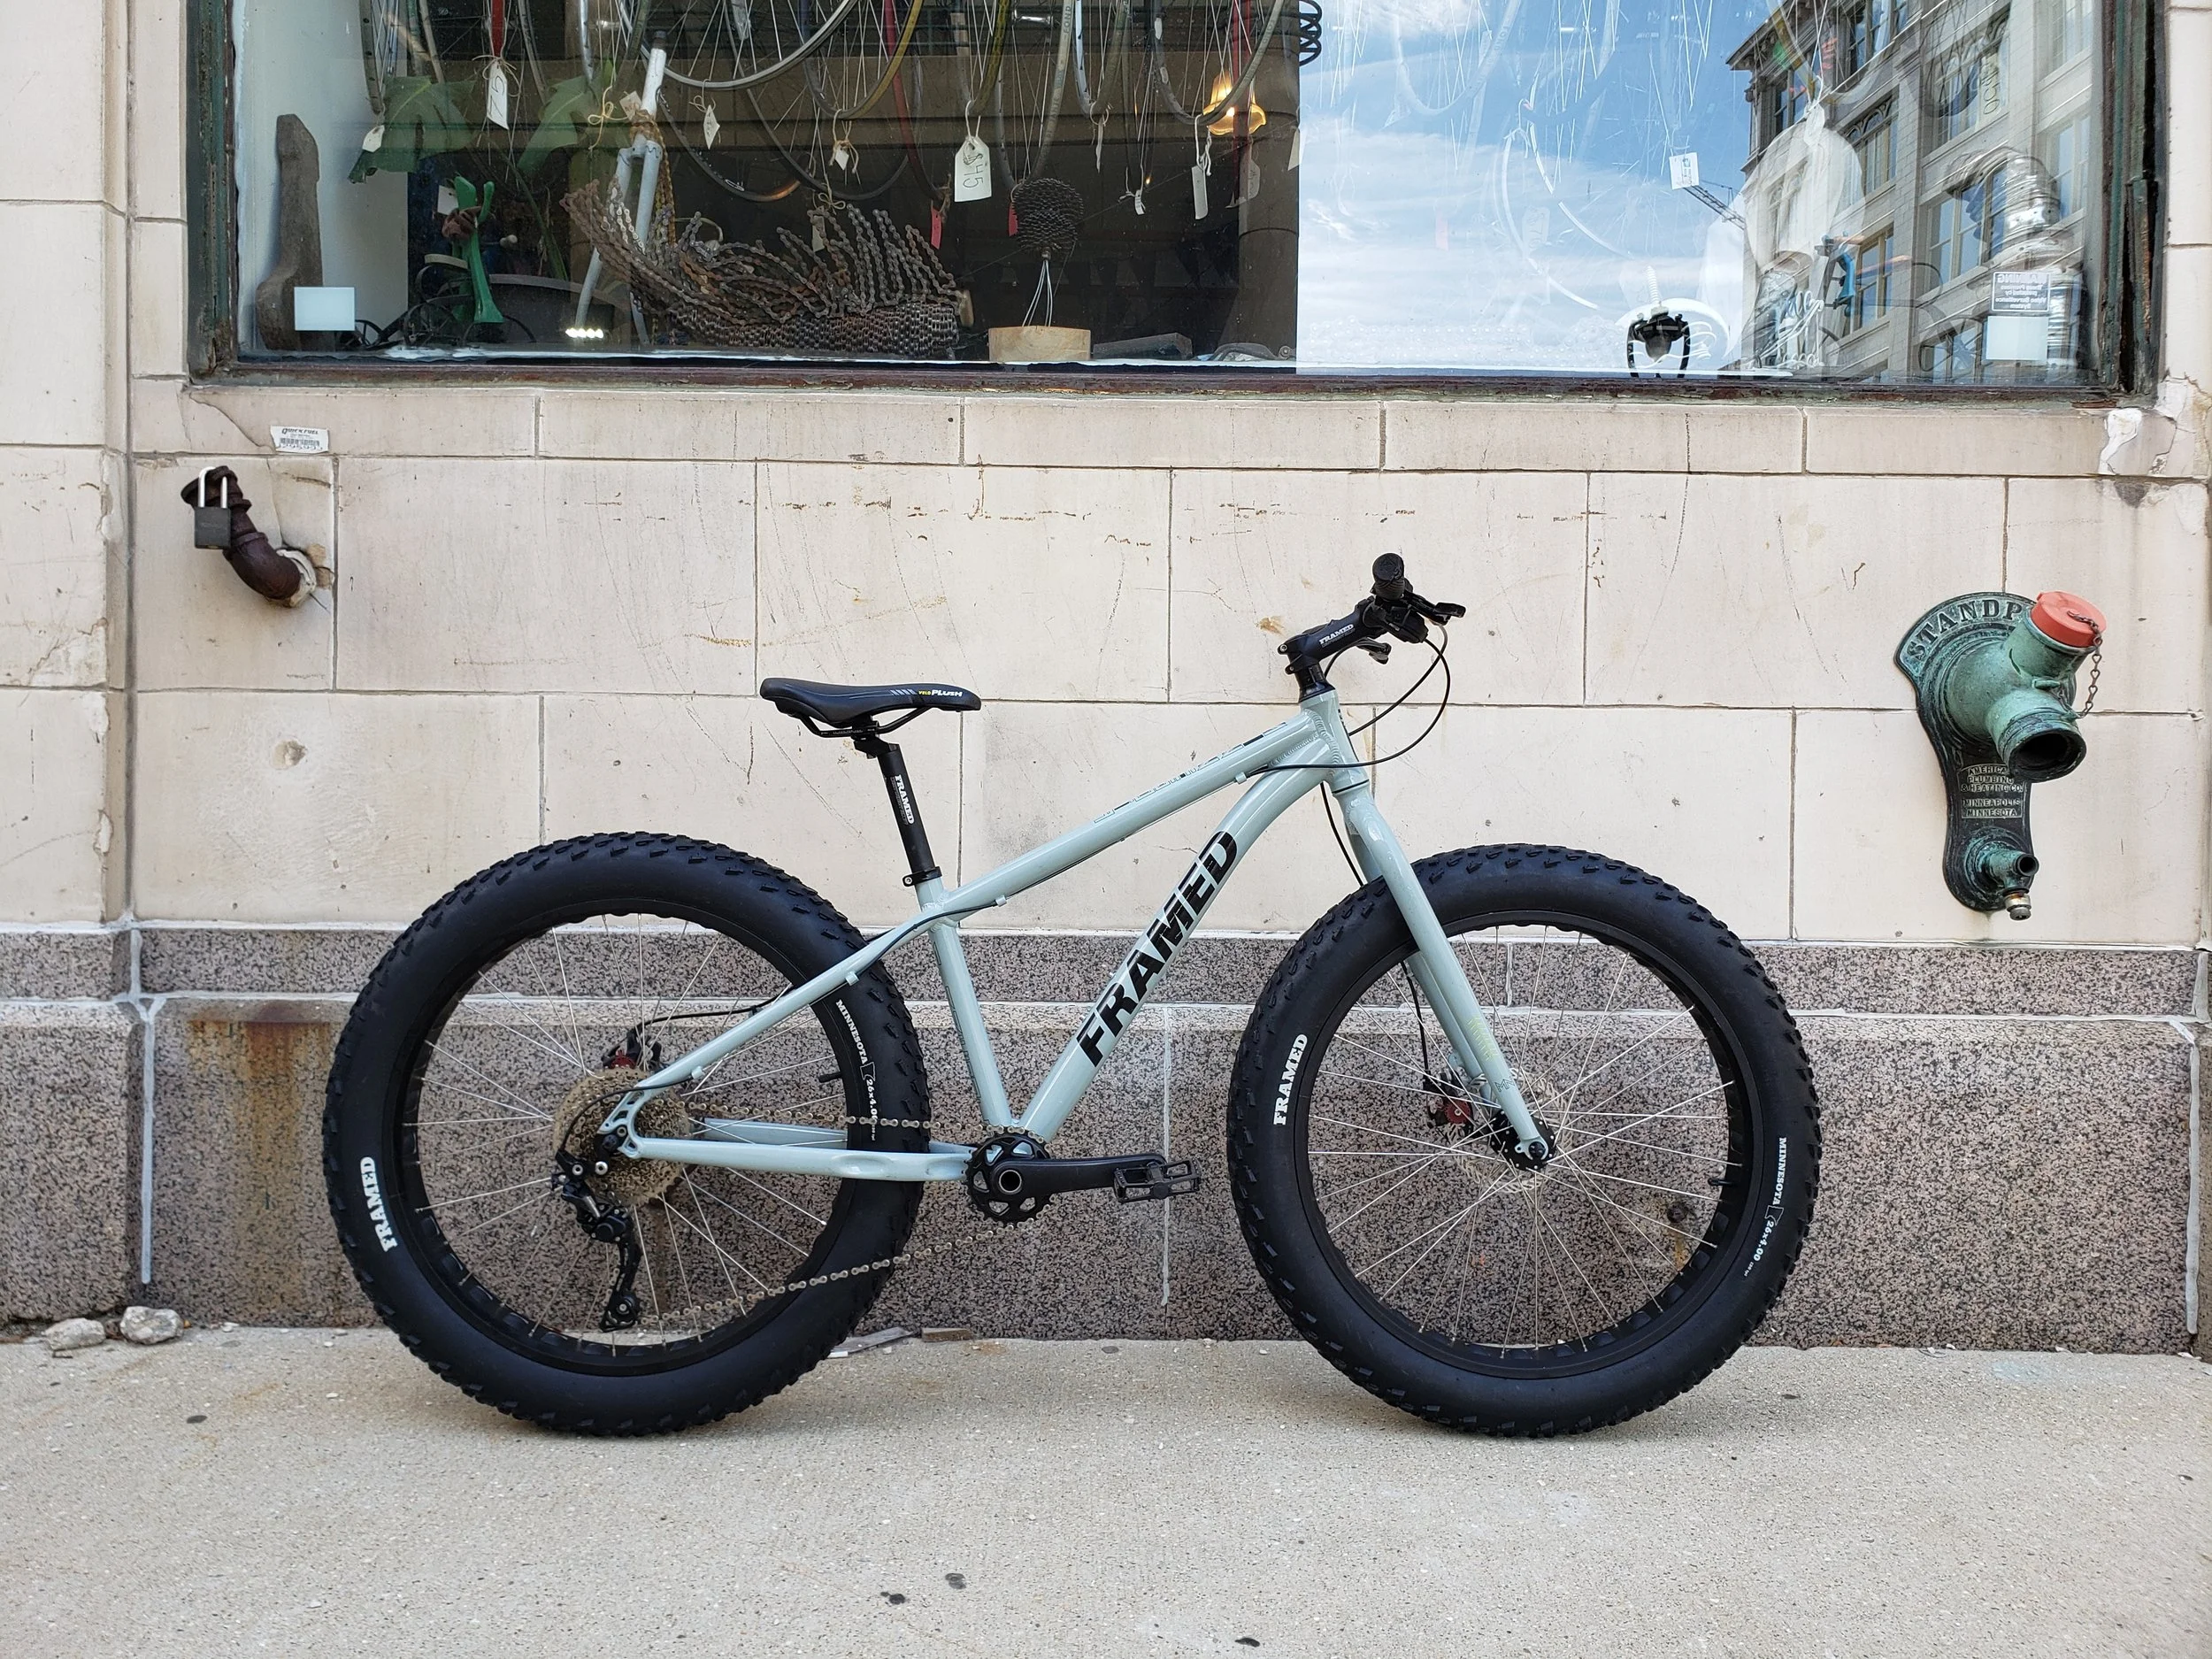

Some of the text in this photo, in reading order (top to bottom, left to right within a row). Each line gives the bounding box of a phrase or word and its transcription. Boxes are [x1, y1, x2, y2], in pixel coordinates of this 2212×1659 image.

[962, 153, 984, 188] $45
[1318, 623, 1355, 645] FRAMED
[1906, 599, 2023, 661] STANDP
[1967, 775, 2015, 785] PLUMBING
[1968, 765, 2007, 776] AMERICA
[1970, 783, 2009, 793] HEATING
[895, 773, 915, 825] FRAMED
[1962, 798, 2021, 807] MINNEAPOLIS
[1966, 808, 2017, 817] MINNESOTA
[1076, 830, 1238, 1068] FRAMED
[835, 999, 868, 1065] MINNESOTA
[1272, 1033, 1308, 1125] FRAMED
[1772, 1137, 1787, 1206] MINNESOTA
[360, 1156, 398, 1252] FRAMED
[1753, 1220, 1775, 1262] 26x4.00
